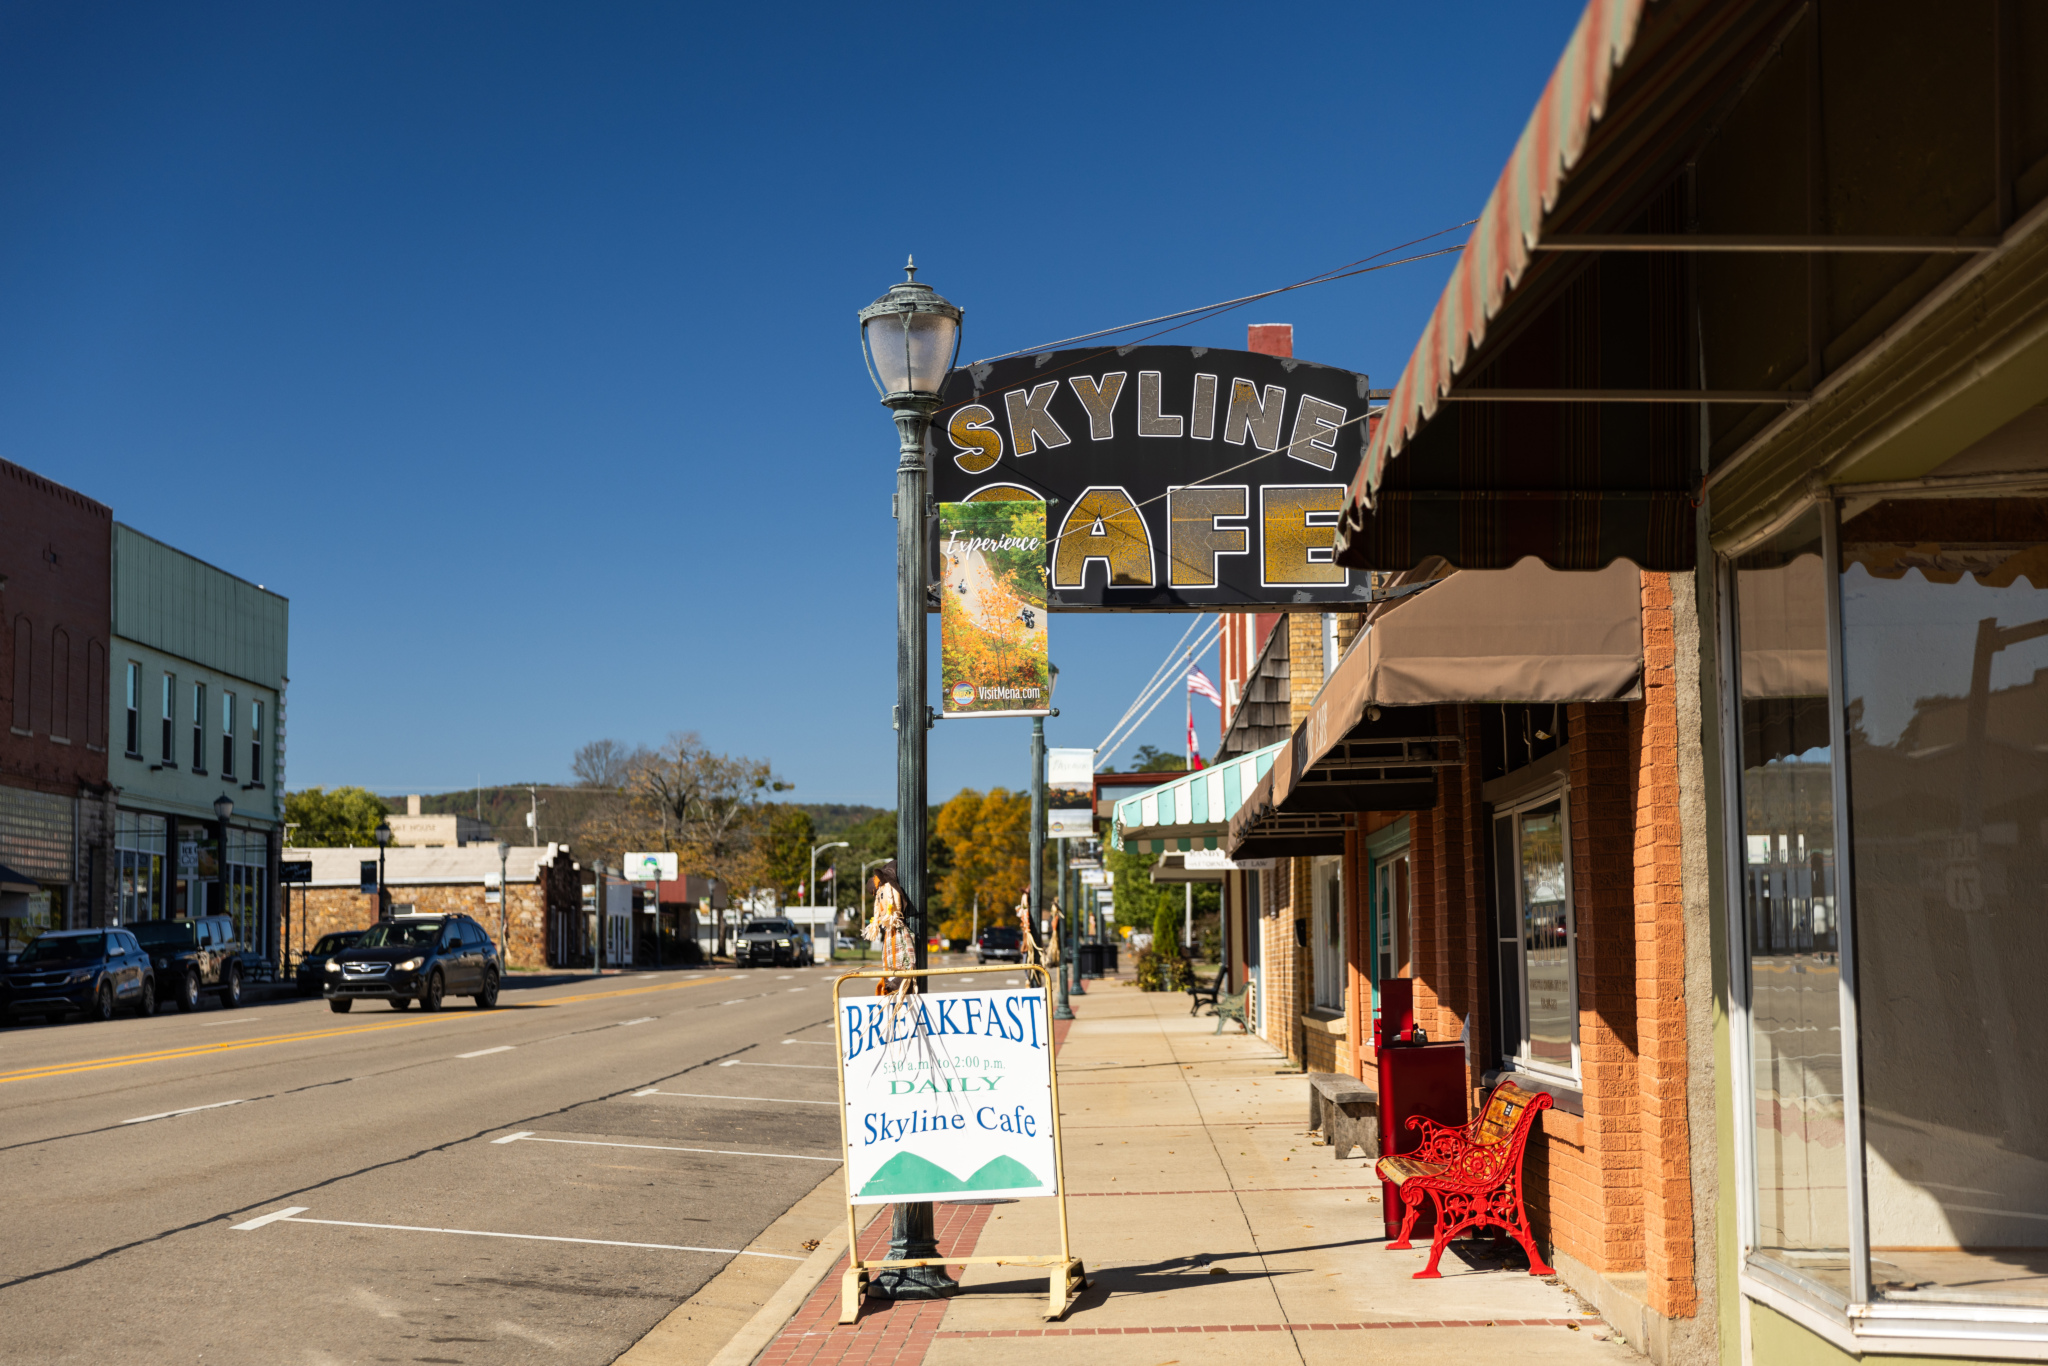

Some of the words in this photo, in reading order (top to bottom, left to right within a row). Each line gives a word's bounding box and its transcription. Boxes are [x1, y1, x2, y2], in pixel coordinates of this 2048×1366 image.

[948, 370, 1348, 475] SKYLINE
[946, 529, 1041, 560] Experience
[961, 481, 1350, 590] AFE
[978, 686, 1040, 700] VisitMena.com
[846, 995, 1042, 1061] BREAKFAST
[938, 1058, 949, 1069] to
[954, 1056, 979, 1069] 2:00
[983, 1058, 1006, 1071] p.m.
[889, 1076, 1006, 1095] DAILY
[864, 1110, 966, 1147] Skyline
[976, 1105, 1037, 1138] Cafe
